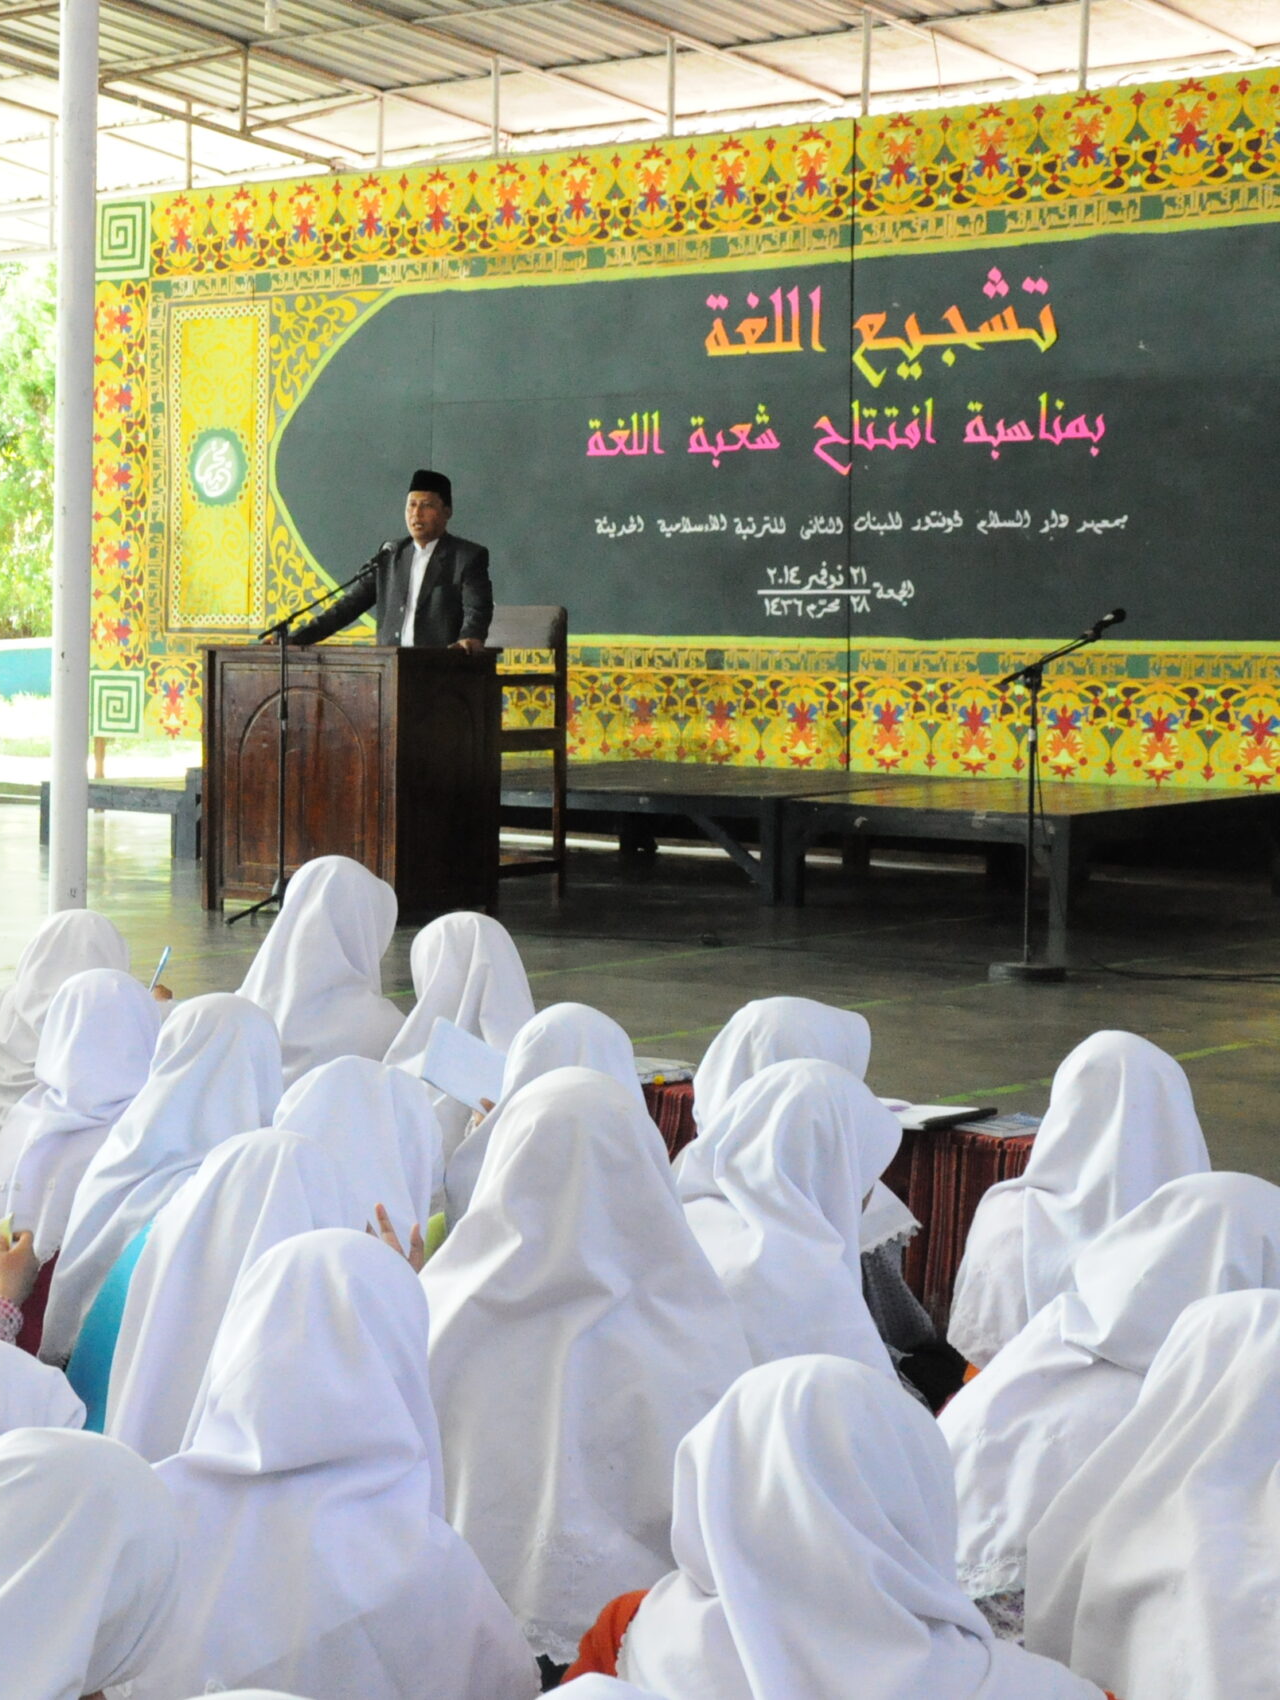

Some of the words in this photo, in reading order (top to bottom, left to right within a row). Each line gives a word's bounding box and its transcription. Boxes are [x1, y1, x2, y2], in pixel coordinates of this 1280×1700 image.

[705, 285, 827, 357] اللغة
[852, 267, 1058, 389] تشجيع
[585, 410, 666, 457] اللغة
[687, 403, 781, 469] شعبة
[813, 397, 937, 477] افتتاح
[963, 391, 1107, 461] بمناسبة
[975, 509, 1033, 536] السلام
